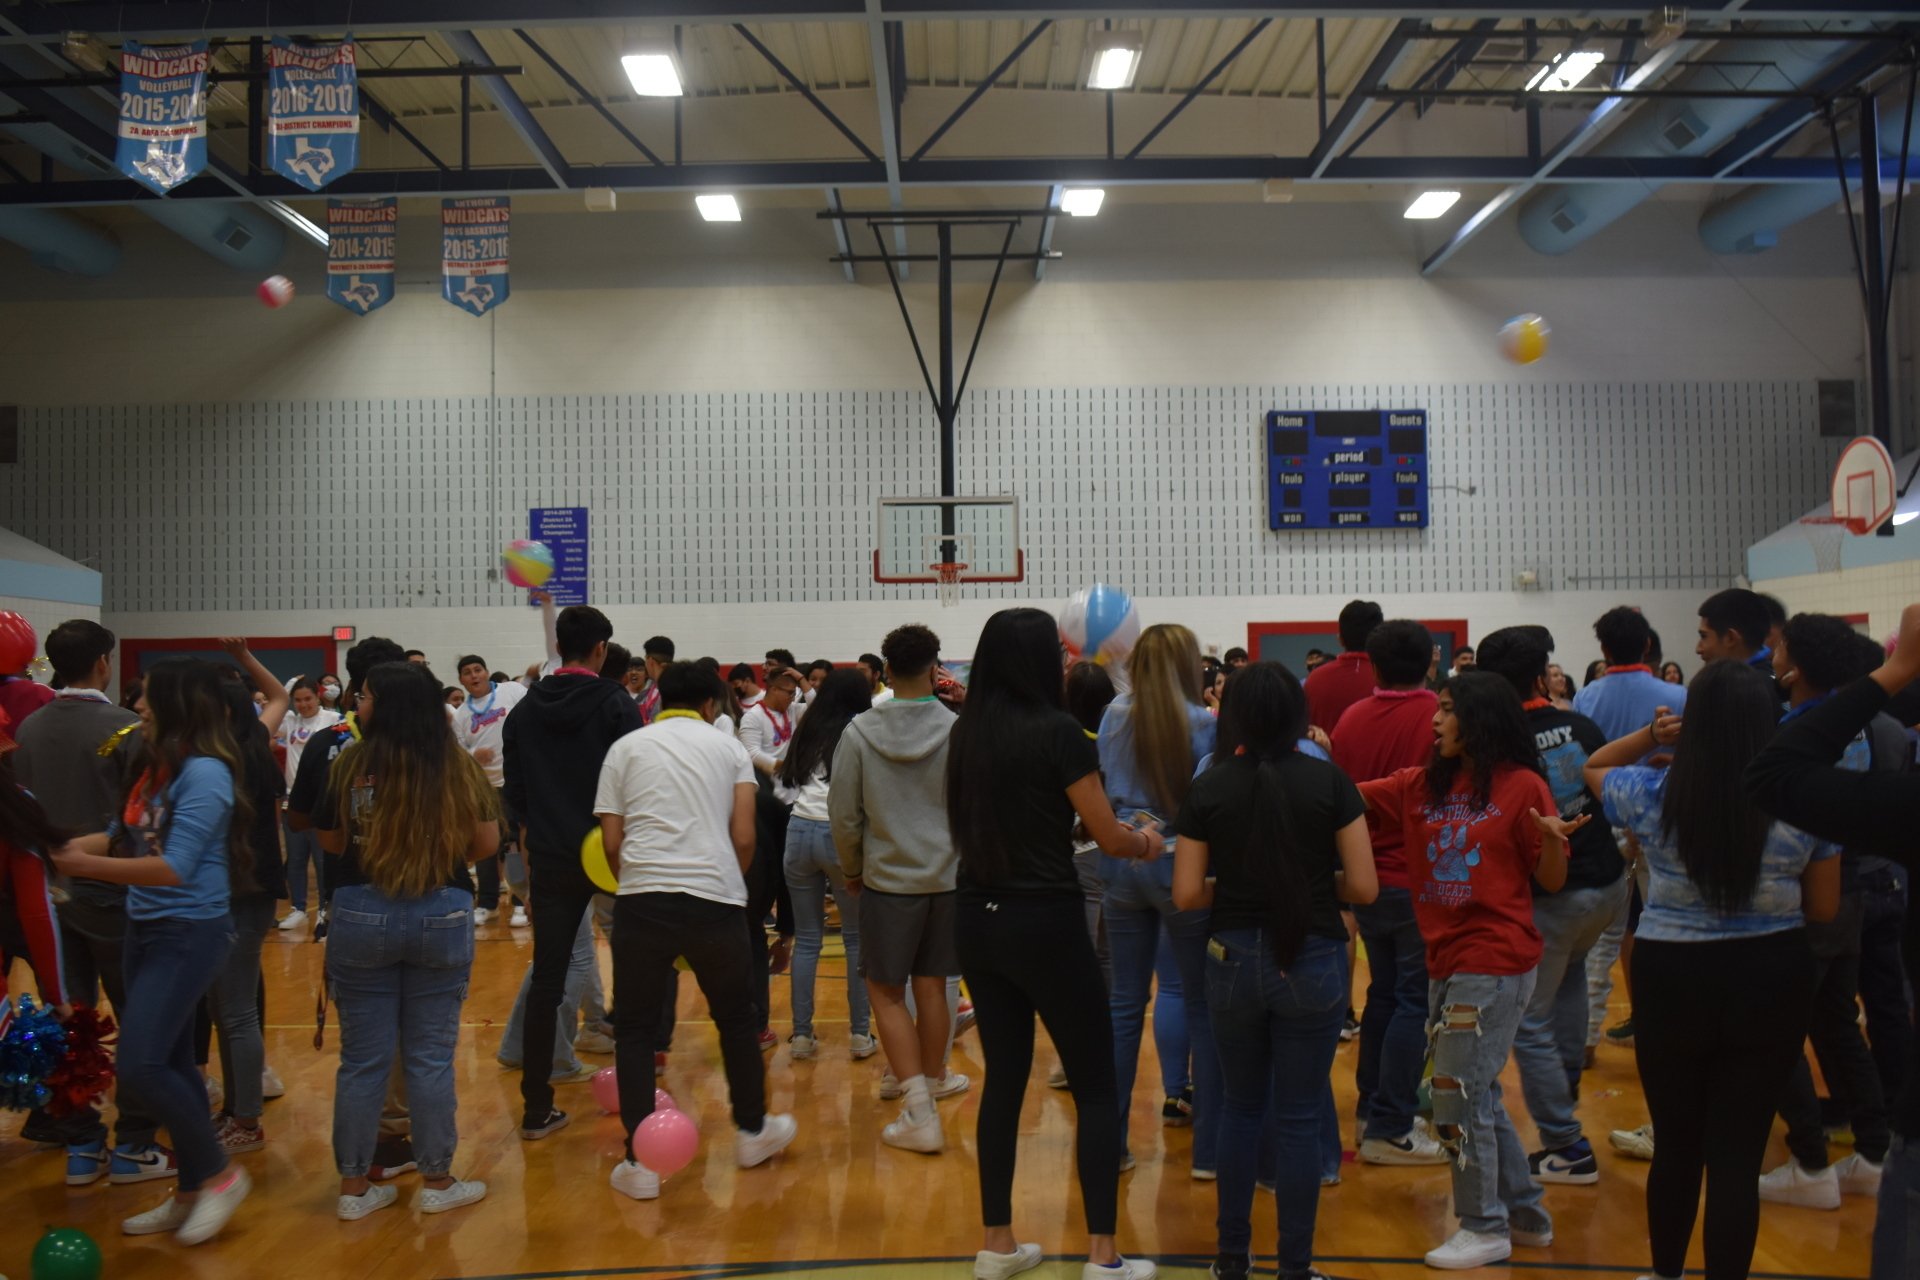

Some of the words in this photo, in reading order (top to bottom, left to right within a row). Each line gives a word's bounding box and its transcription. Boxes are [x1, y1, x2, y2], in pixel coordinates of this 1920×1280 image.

[123, 53, 208, 78] WILDCATS
[139, 78, 192, 93] VOLLEYBALL
[271, 84, 353, 114] 2016-2017
[120, 91, 207, 121] 2015-2016
[312, 120, 353, 129] CHAMPIONS
[454, 198, 497, 208] ANTHONY
[329, 207, 396, 224] WILDCATS
[443, 207, 510, 224] WILDCATS
[329, 237, 395, 258] 2014-2015
[443, 237, 510, 260] 2015-2016
[1277, 415, 1303, 427] Home
[1389, 414, 1422, 426] Guests
[1334, 451, 1364, 464] period
[1281, 473, 1303, 485] fouls
[1335, 472, 1366, 485] player
[1396, 472, 1418, 483] fouls
[1283, 513, 1302, 523] won
[1338, 512, 1362, 525] game
[1399, 512, 1418, 522] won
[1486, 803, 1502, 817] OF
